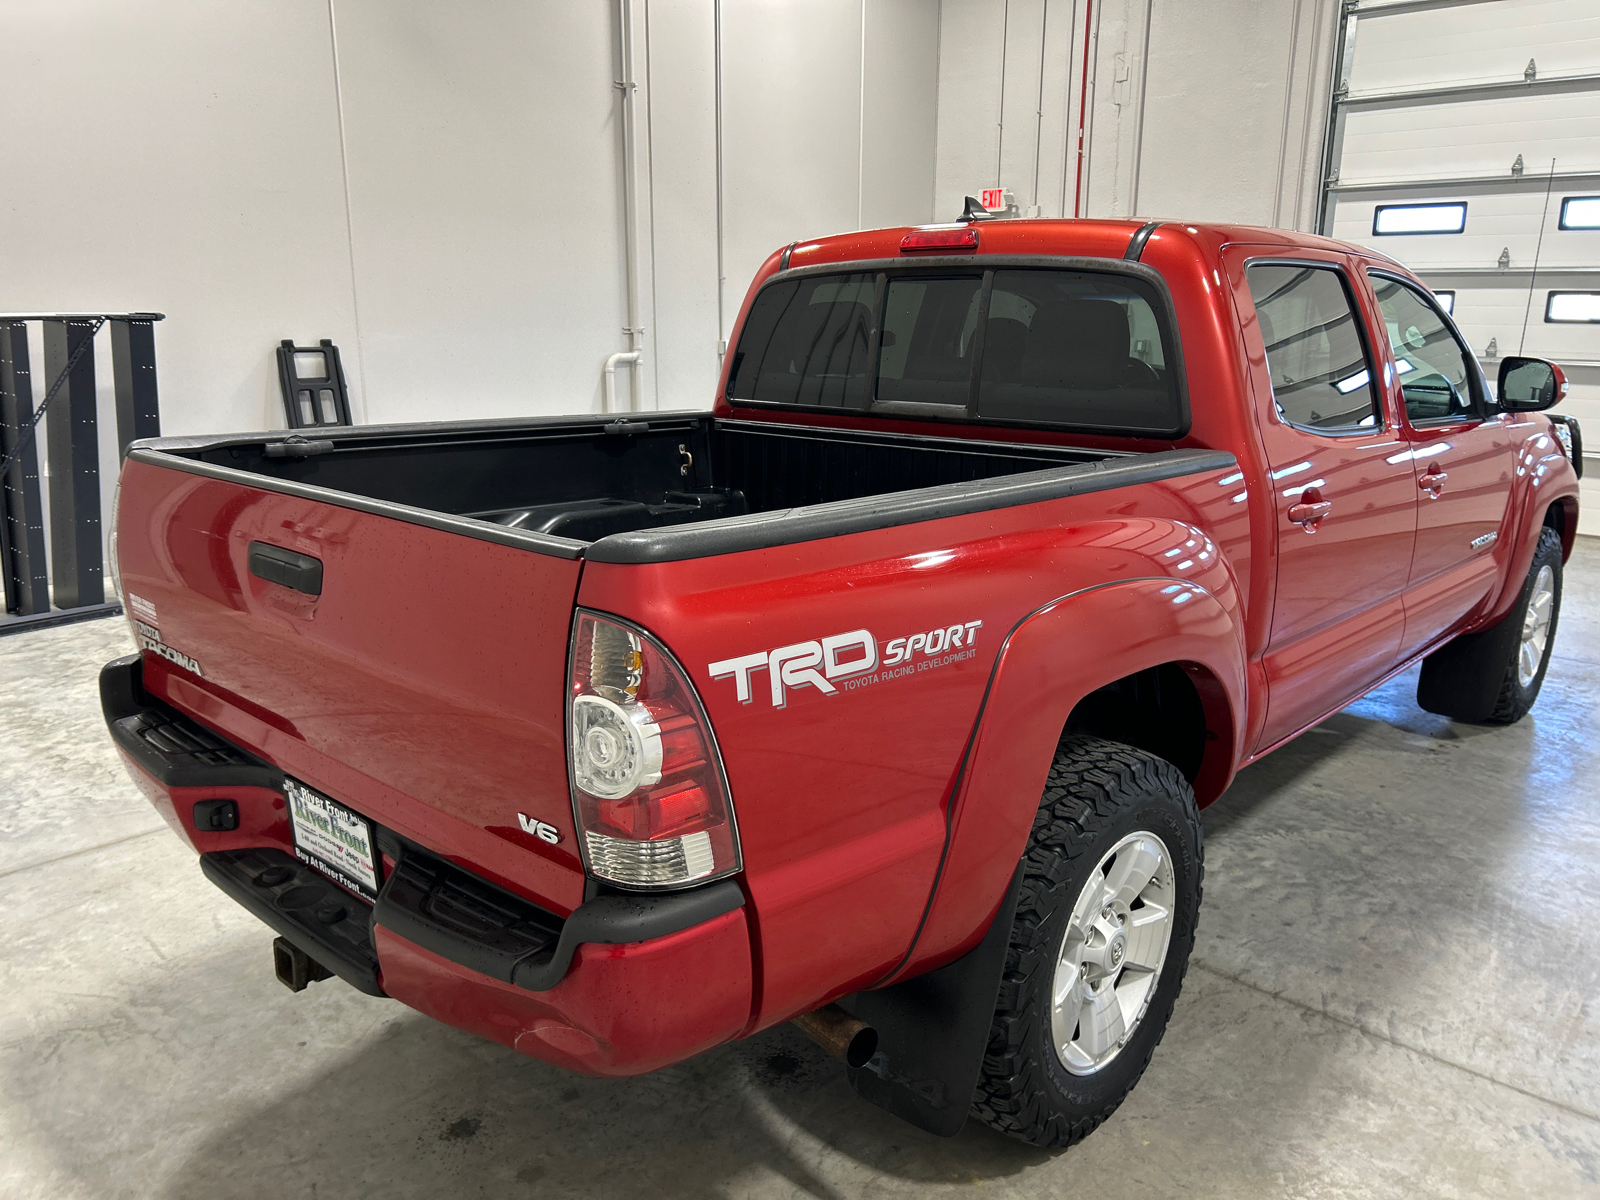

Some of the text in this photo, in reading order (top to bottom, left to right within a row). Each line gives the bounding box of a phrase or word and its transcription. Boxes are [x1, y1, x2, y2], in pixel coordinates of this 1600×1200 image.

[982, 189, 1003, 209] EXIT
[139, 634, 205, 676] TACOMA
[708, 620, 983, 710] TRD SPORT
[843, 649, 977, 691] TOYOTA RACING DEVELOPMENT
[300, 786, 324, 809] River
[325, 799, 349, 822] Front
[295, 796, 370, 858] River Front
[518, 811, 561, 845] V6
[295, 846, 310, 864] Buy
[310, 856, 319, 869] At
[319, 860, 339, 880] River
[344, 848, 360, 864] Jeep
